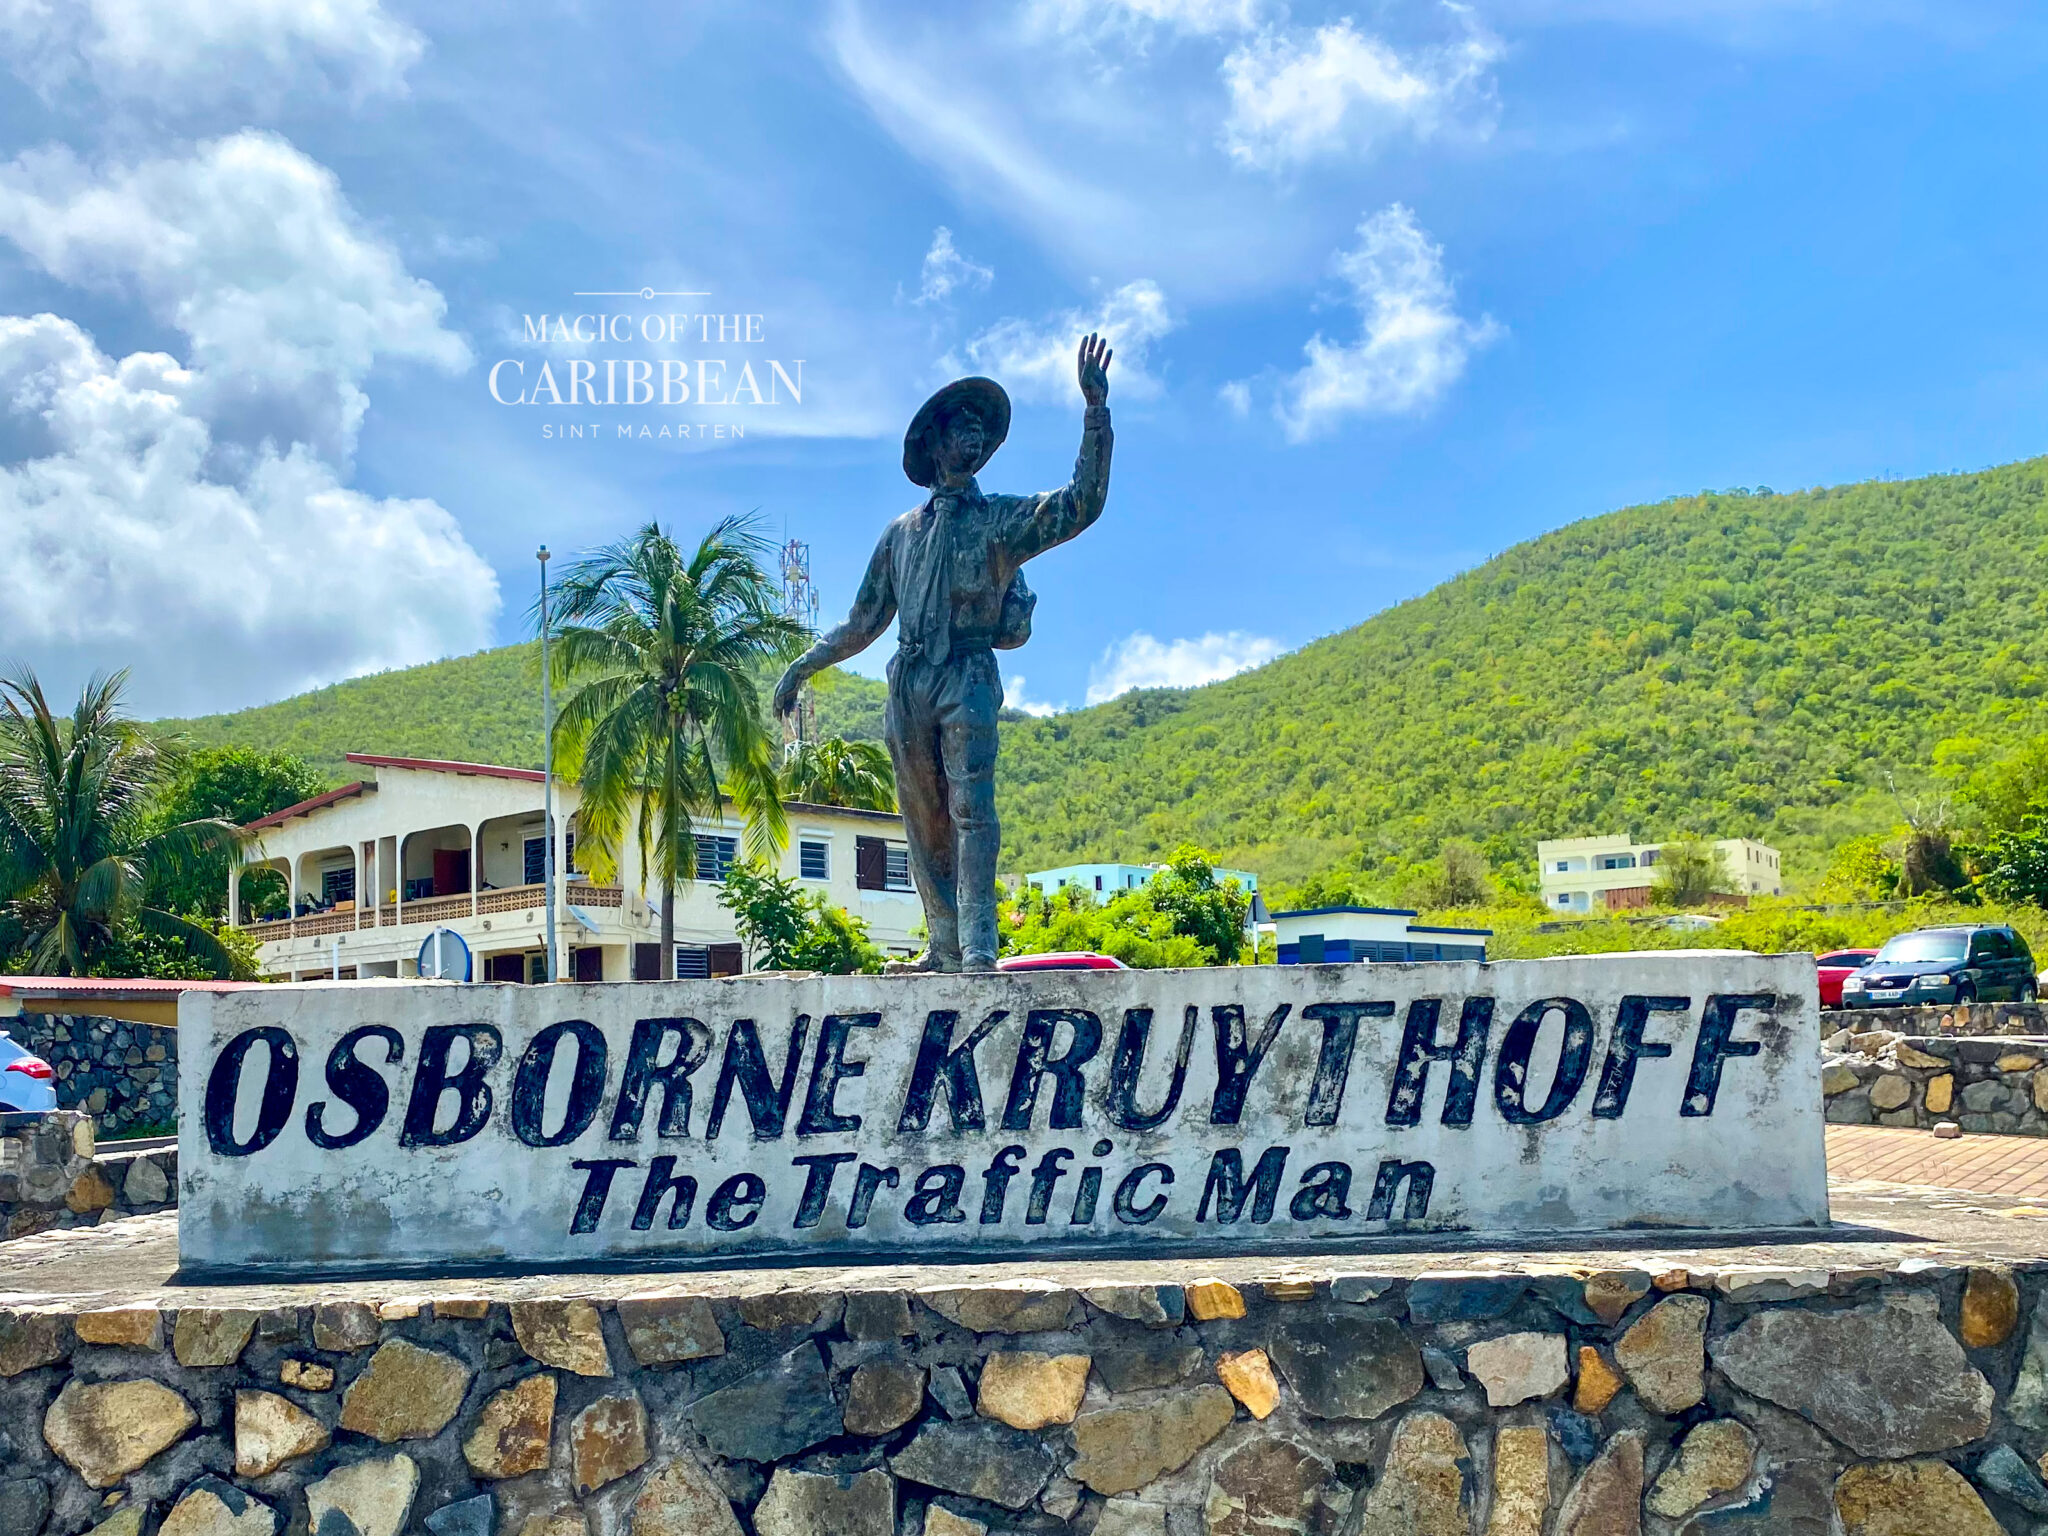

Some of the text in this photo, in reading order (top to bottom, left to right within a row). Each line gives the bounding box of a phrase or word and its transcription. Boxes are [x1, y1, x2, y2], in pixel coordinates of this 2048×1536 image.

[204, 994, 1776, 1157] OSBORNE KRUYTHOFF
[570, 1139, 1436, 1236] The Traffic Man
